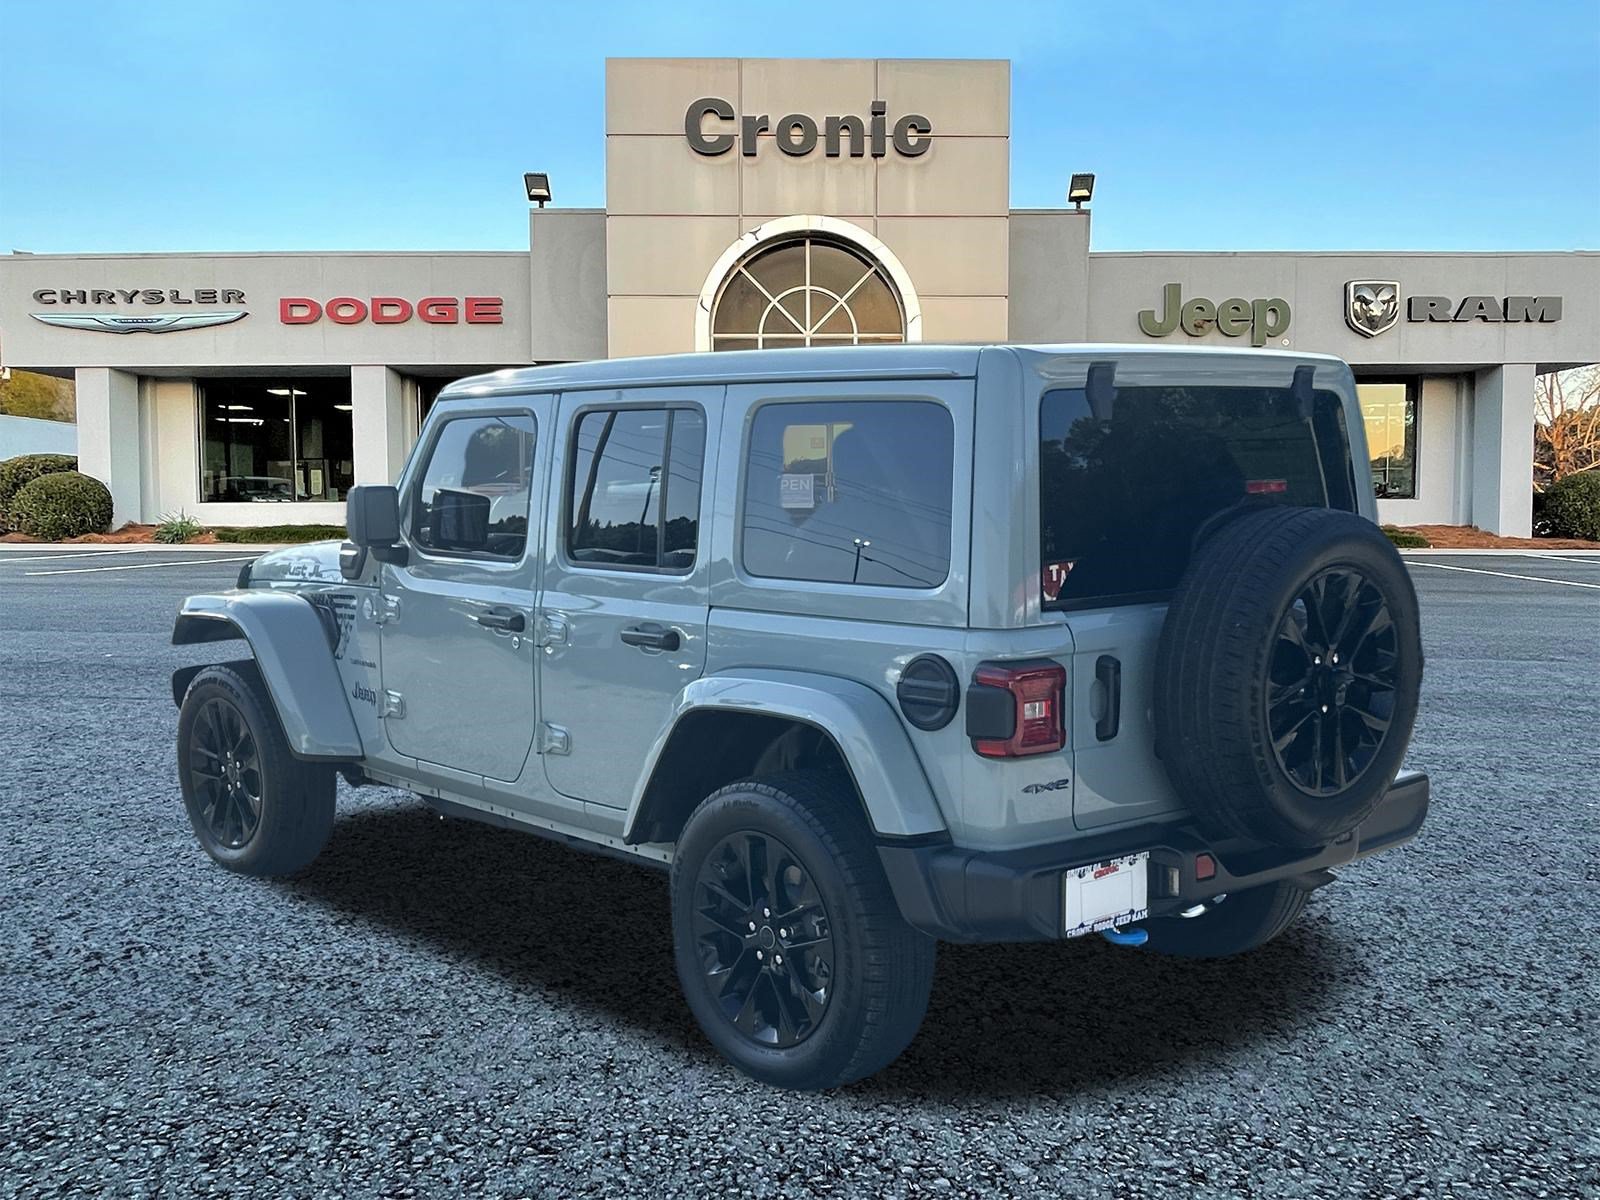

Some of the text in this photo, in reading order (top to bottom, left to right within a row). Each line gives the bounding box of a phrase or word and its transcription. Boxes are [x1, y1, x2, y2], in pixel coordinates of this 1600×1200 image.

[685, 97, 932, 157] Cronic
[32, 289, 247, 305] CHRYSLER
[280, 297, 503, 324] DODGE
[1407, 296, 1563, 323] RAM
[1138, 283, 1291, 347] Jeep
